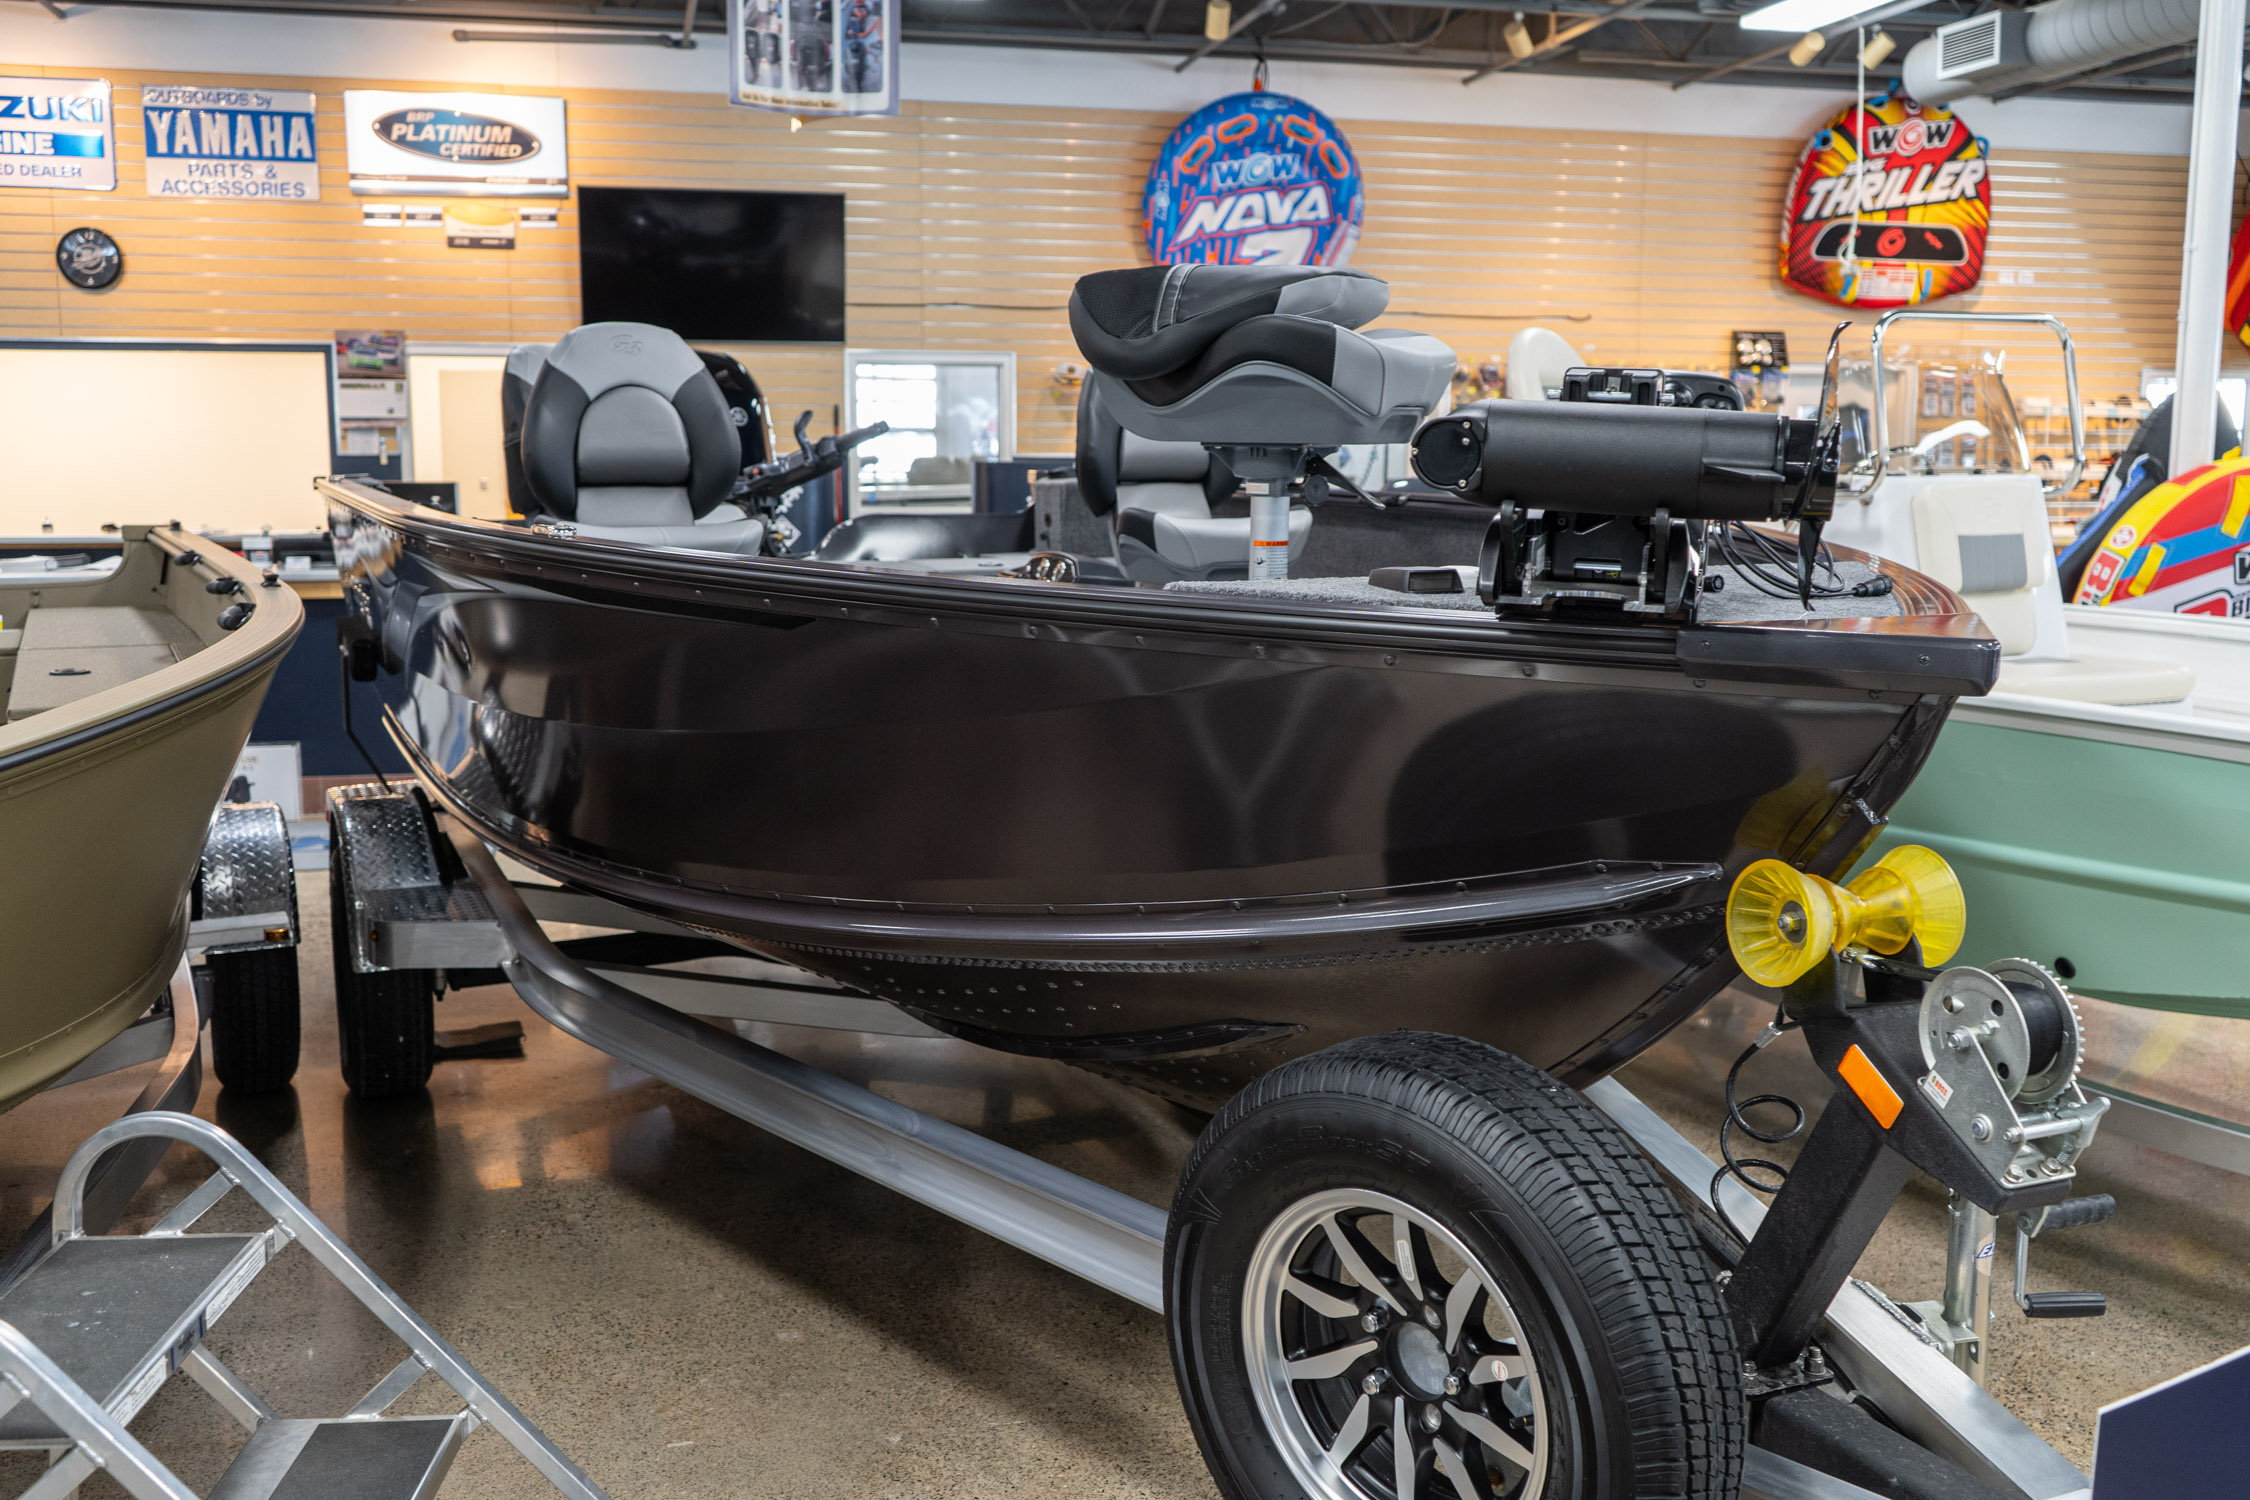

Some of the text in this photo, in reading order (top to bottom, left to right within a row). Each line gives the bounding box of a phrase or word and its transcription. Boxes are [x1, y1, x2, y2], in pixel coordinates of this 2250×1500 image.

[0, 95, 103, 122] ZUKI
[148, 88, 273, 109] OUTBOARDS by
[406, 111, 435, 123] BRP
[0, 131, 55, 155] INE
[146, 109, 313, 158] YAMAHA
[390, 123, 513, 143] PLATINUM
[1868, 117, 1955, 156] WOW
[439, 142, 522, 158] CERTIFIED
[20, 164, 82, 178] DEALER
[188, 163, 277, 179] PARTS &
[1212, 152, 1300, 187] WOW
[161, 179, 306, 198] ACCESSORIES
[1802, 158, 1986, 221] THRILLER
[1172, 183, 1332, 246] NOVA
